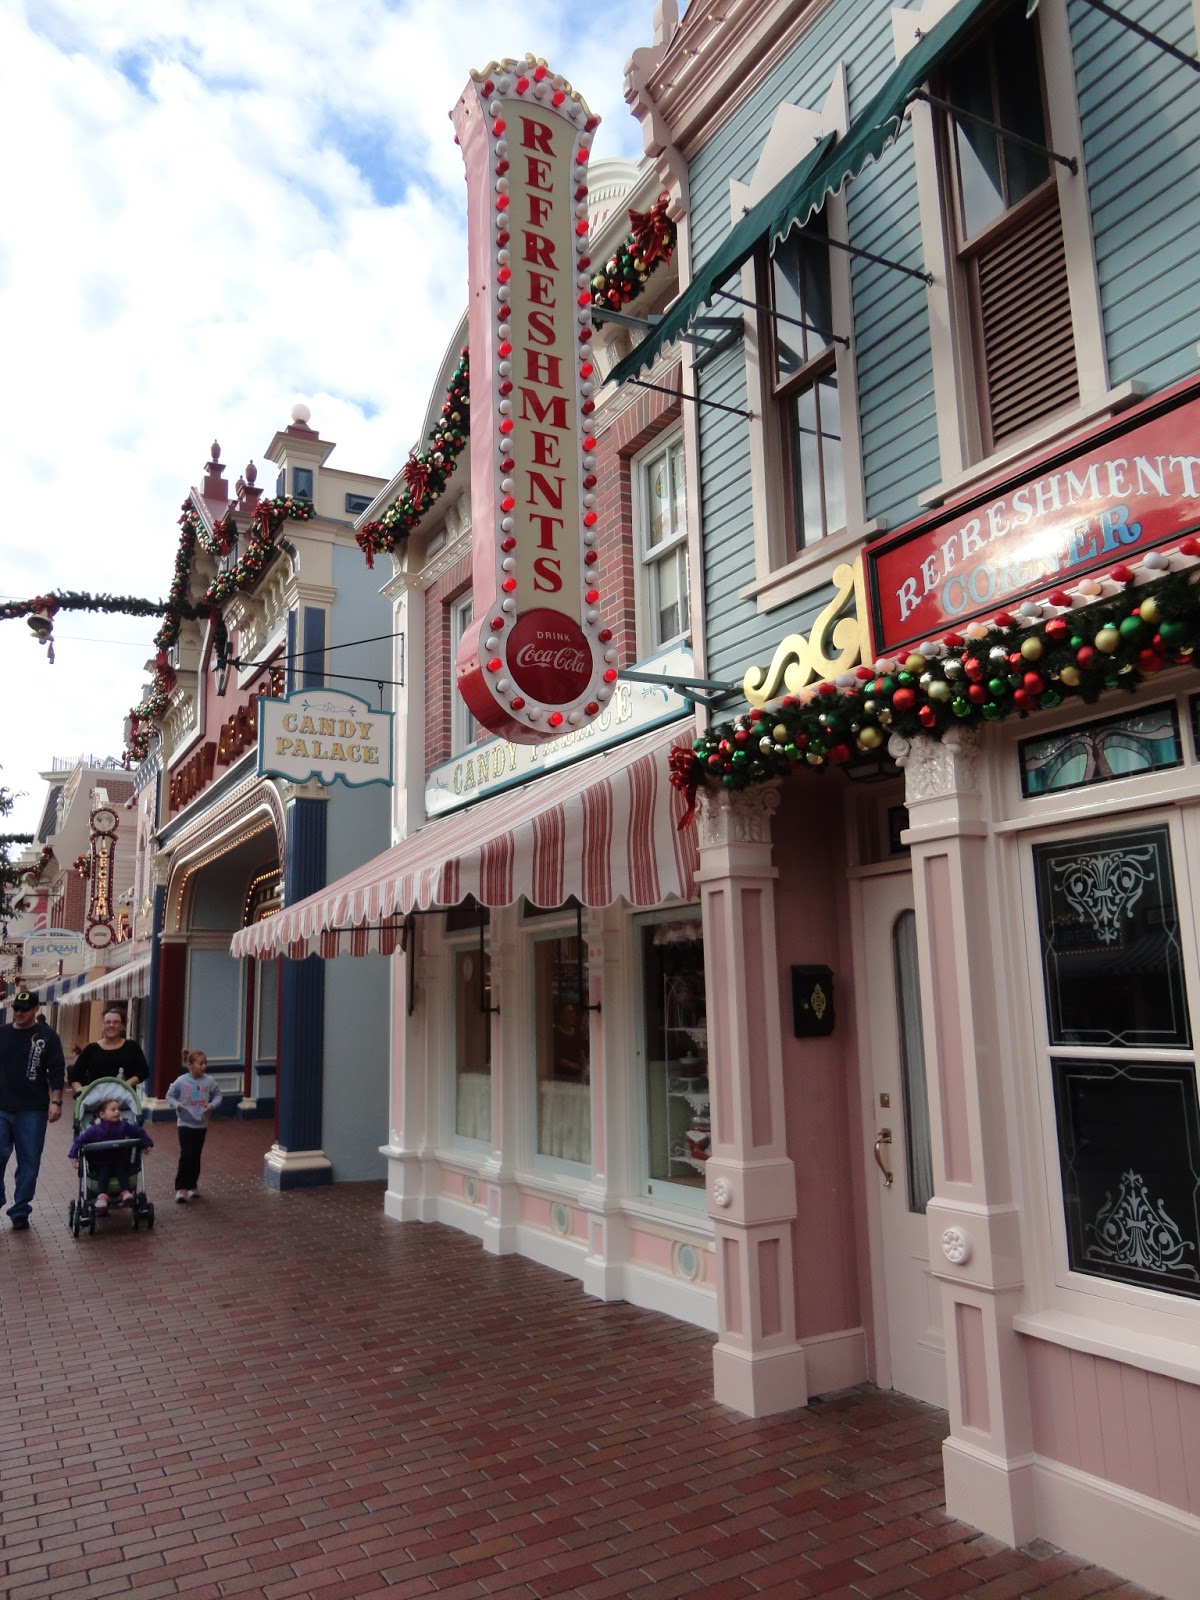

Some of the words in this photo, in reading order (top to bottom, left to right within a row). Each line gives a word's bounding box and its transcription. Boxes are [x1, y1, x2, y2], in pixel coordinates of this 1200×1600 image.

[518, 115, 571, 594] REFRESHMENTS
[536, 631, 571, 642] DRINK
[282, 713, 374, 740] CANDY
[276, 736, 379, 764] PALACE
[453, 741, 517, 795] CANDY
[31, 944, 45, 955] ICE
[46, 943, 78, 956] CREAM
